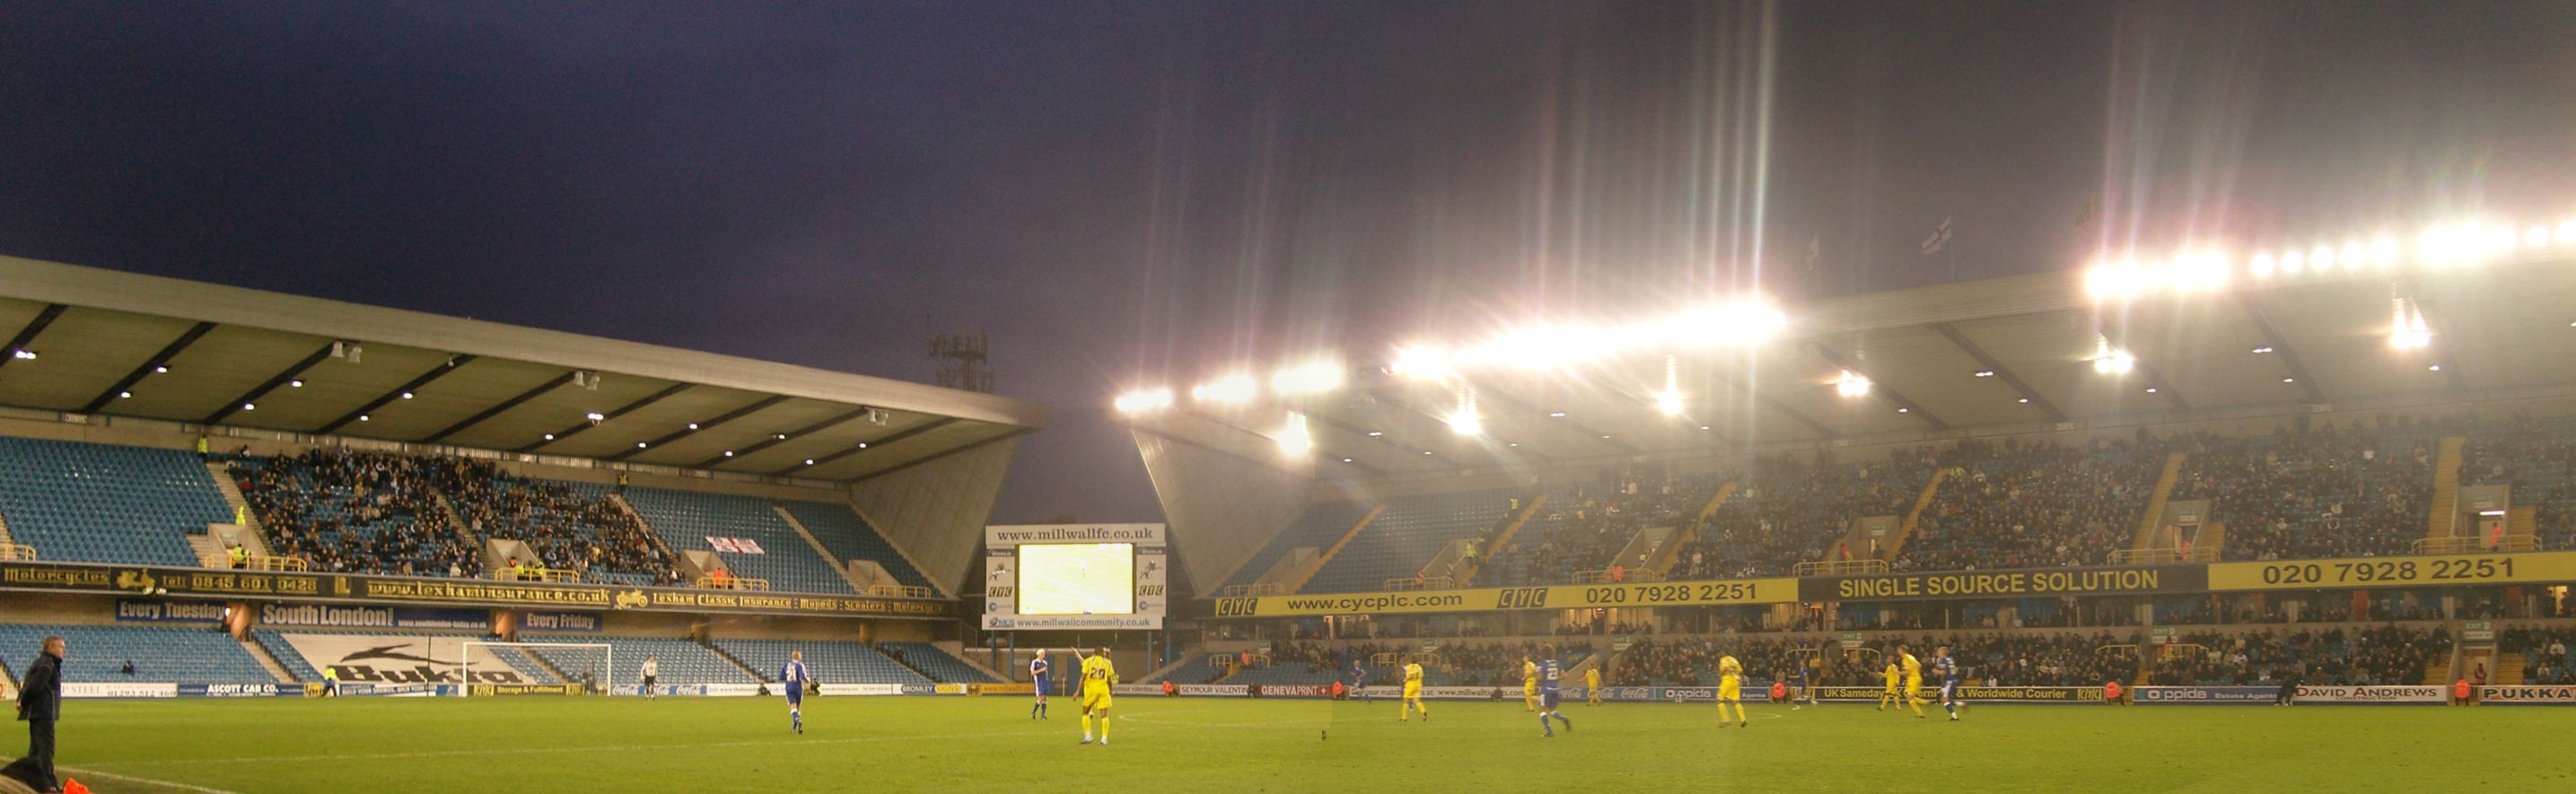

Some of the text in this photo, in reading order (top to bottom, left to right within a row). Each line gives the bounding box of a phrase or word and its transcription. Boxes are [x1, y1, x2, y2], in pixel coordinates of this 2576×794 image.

[997, 528, 1153, 540] www.millwallfc.co.uk
[4, 567, 110, 586] Motorcycles
[2263, 558, 2514, 584] 020 7928 2251
[192, 575, 234, 589] 0845
[241, 577, 271, 590] 601
[277, 578, 317, 592] 0428
[1839, 570, 2159, 598] SINGLE SOURCE SOLUTION
[368, 580, 610, 602] www.lexhaminsurance.co.uk
[653, 592, 695, 605] Lexham
[697, 594, 738, 606] Classic
[740, 596, 792, 608] Insurance
[800, 598, 837, 611] Mopeds
[845, 600, 886, 612] Scooters
[1219, 583, 1757, 615] CYC www.cycplc.com CYC 020 7928 2251
[120, 601, 224, 621] Every Tuesday
[263, 604, 318, 624] South
[527, 613, 594, 630] Every Friday
[1017, 618, 1150, 628] www.millwallcommunity.co.uk
[328, 665, 523, 683] Bukta
[207, 684, 241, 694] ASCOTT
[243, 684, 261, 694] CAB
[263, 684, 279, 694] CO.
[497, 685, 522, 694] Storage
[523, 685, 530, 694] &
[902, 685, 933, 694] BROMLEY
[935, 685, 959, 694] SIGNS
[1181, 685, 1249, 694] SEYMOUR VALENTIN
[1261, 685, 1319, 695] GENEVAPRINT
[1438, 688, 1525, 696] www.millwallticts.com
[1622, 687, 1649, 698] Coca-Cola
[1824, 688, 1838, 698] UK
[1840, 688, 1885, 700] Sameday
[1956, 688, 1965, 698] &
[1967, 688, 2023, 699] Worldwide
[2026, 688, 2067, 699] Courier
[2295, 686, 2438, 698] DAVID ANDREWS
[2214, 692, 2244, 700] Estate
